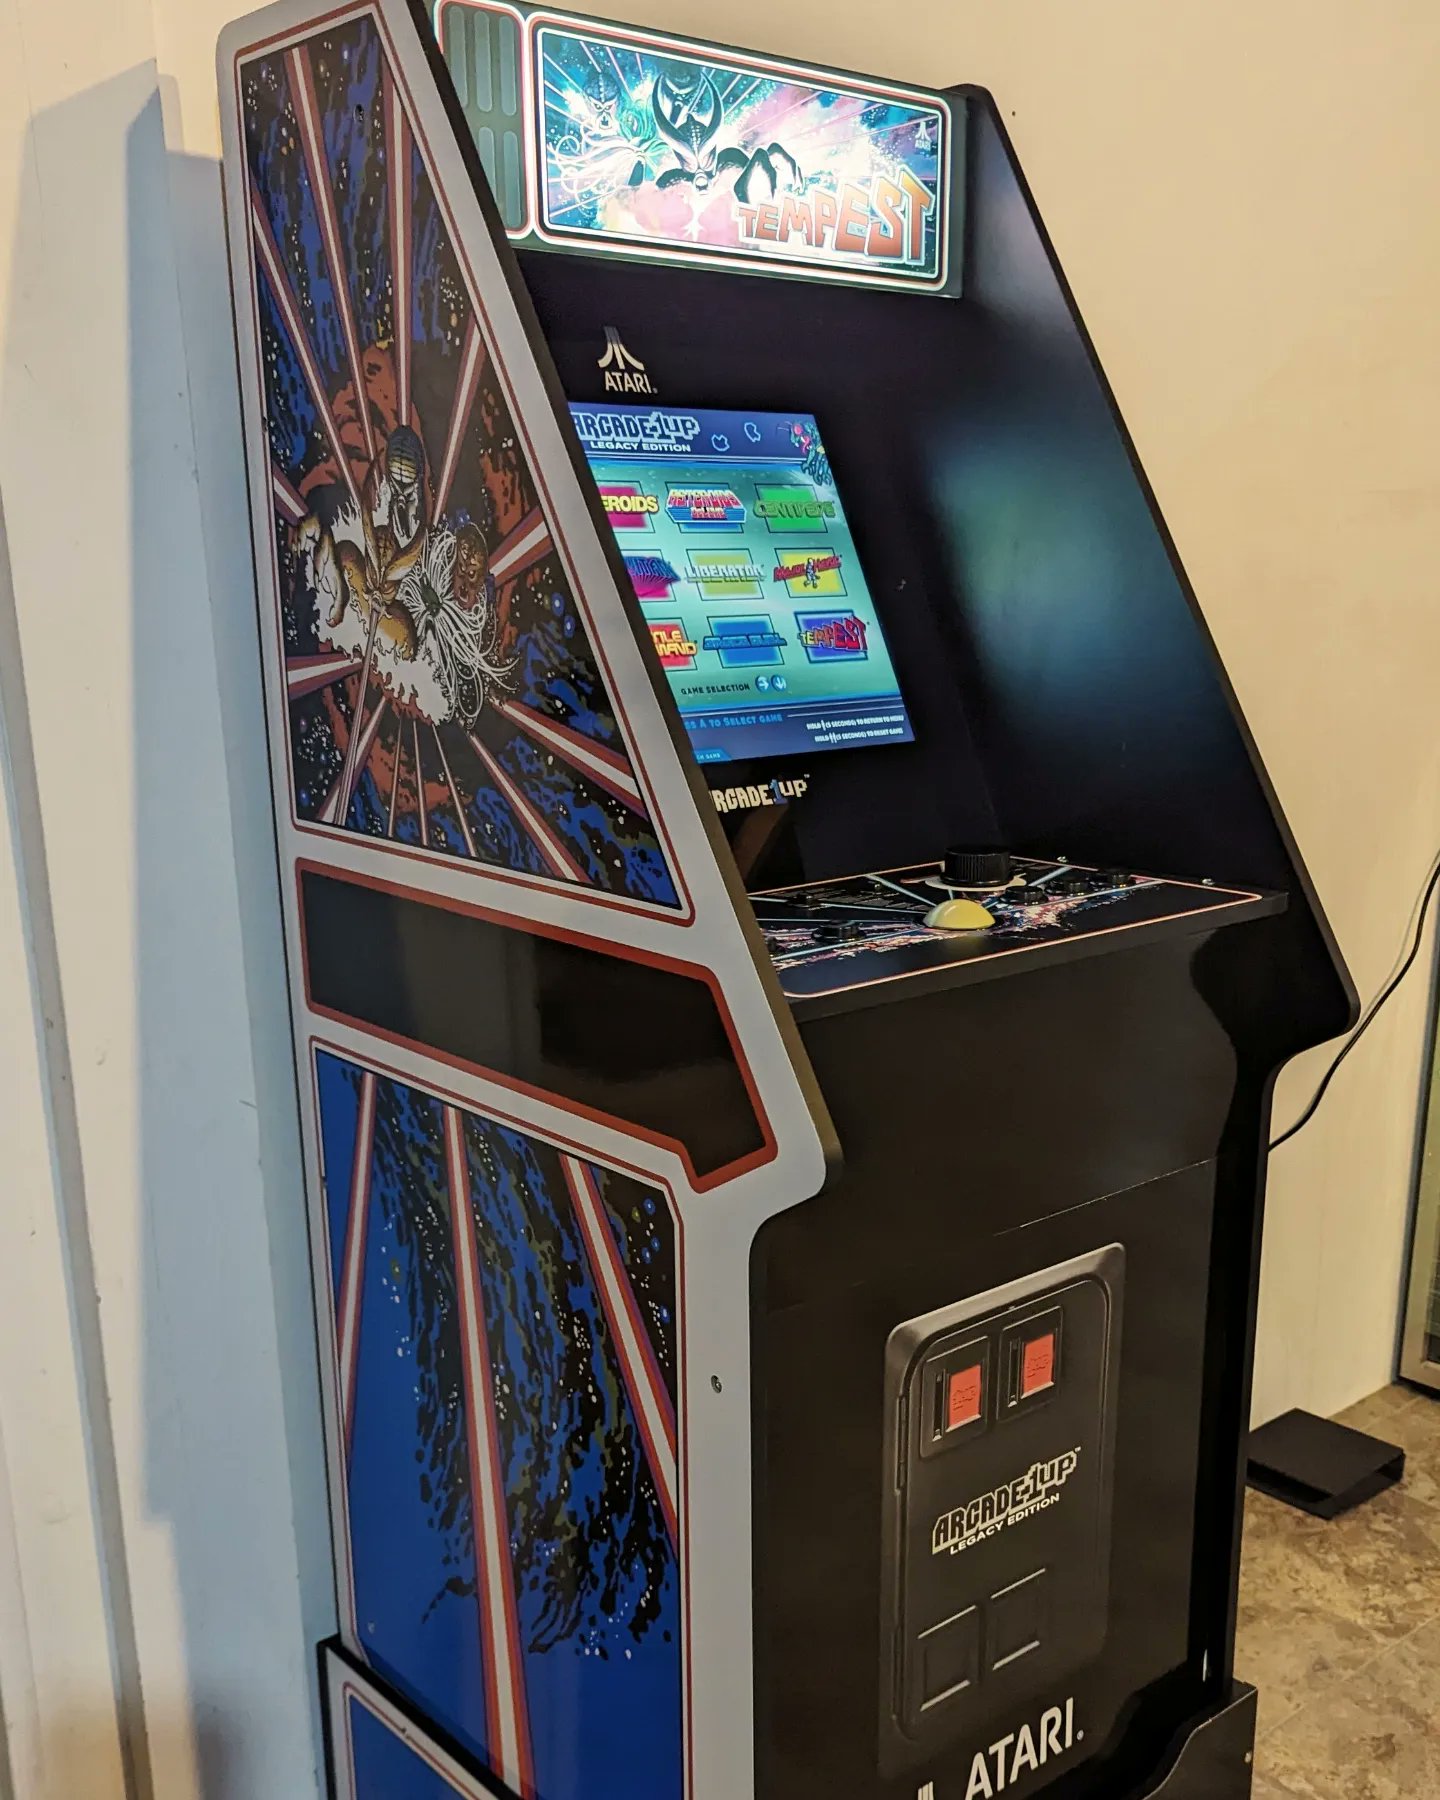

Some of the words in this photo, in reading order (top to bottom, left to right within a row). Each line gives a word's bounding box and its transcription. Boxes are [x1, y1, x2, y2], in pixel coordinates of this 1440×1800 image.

[734, 164, 935, 266] TEMPEST
[604, 370, 653, 395] ATARI
[590, 440, 639, 451] LEGACY
[642, 442, 692, 453] EDITION
[600, 495, 660, 514] EROIDS
[684, 563, 767, 583] LIBERATOR
[797, 615, 868, 652] TEMPEST
[681, 686, 705, 695] GAME
[706, 683, 751, 694] SELECTION
[723, 714, 756, 727] SELECT
[759, 713, 783, 724] GAME
[708, 778, 808, 813] RCADE1UP
[932, 1451, 1077, 1555] ARCADE1UP
[950, 1522, 1004, 1556] LEGACY
[1007, 1493, 1060, 1527] EDITION
[964, 1697, 1074, 1800] ATARI
